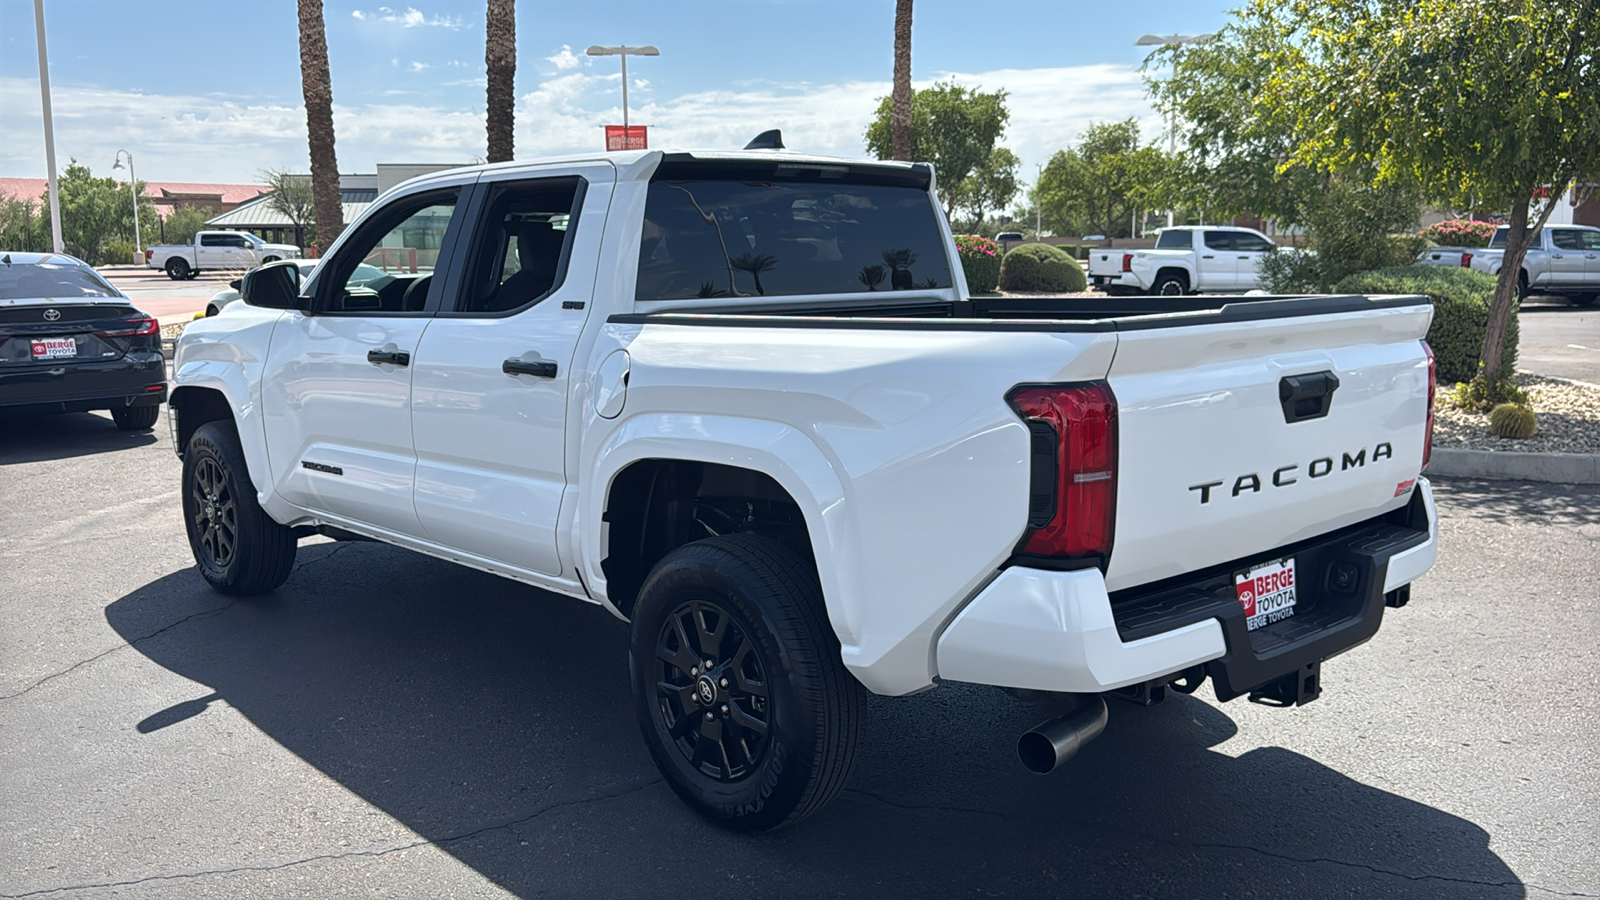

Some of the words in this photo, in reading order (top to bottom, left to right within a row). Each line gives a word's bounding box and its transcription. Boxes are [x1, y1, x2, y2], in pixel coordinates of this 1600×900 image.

[621, 136, 645, 145] BERGE
[1188, 442, 1393, 504] TACOMA
[1256, 568, 1293, 596] BERGE
[1257, 590, 1295, 613] TOYOTA
[1268, 607, 1294, 624] TOYOTA
